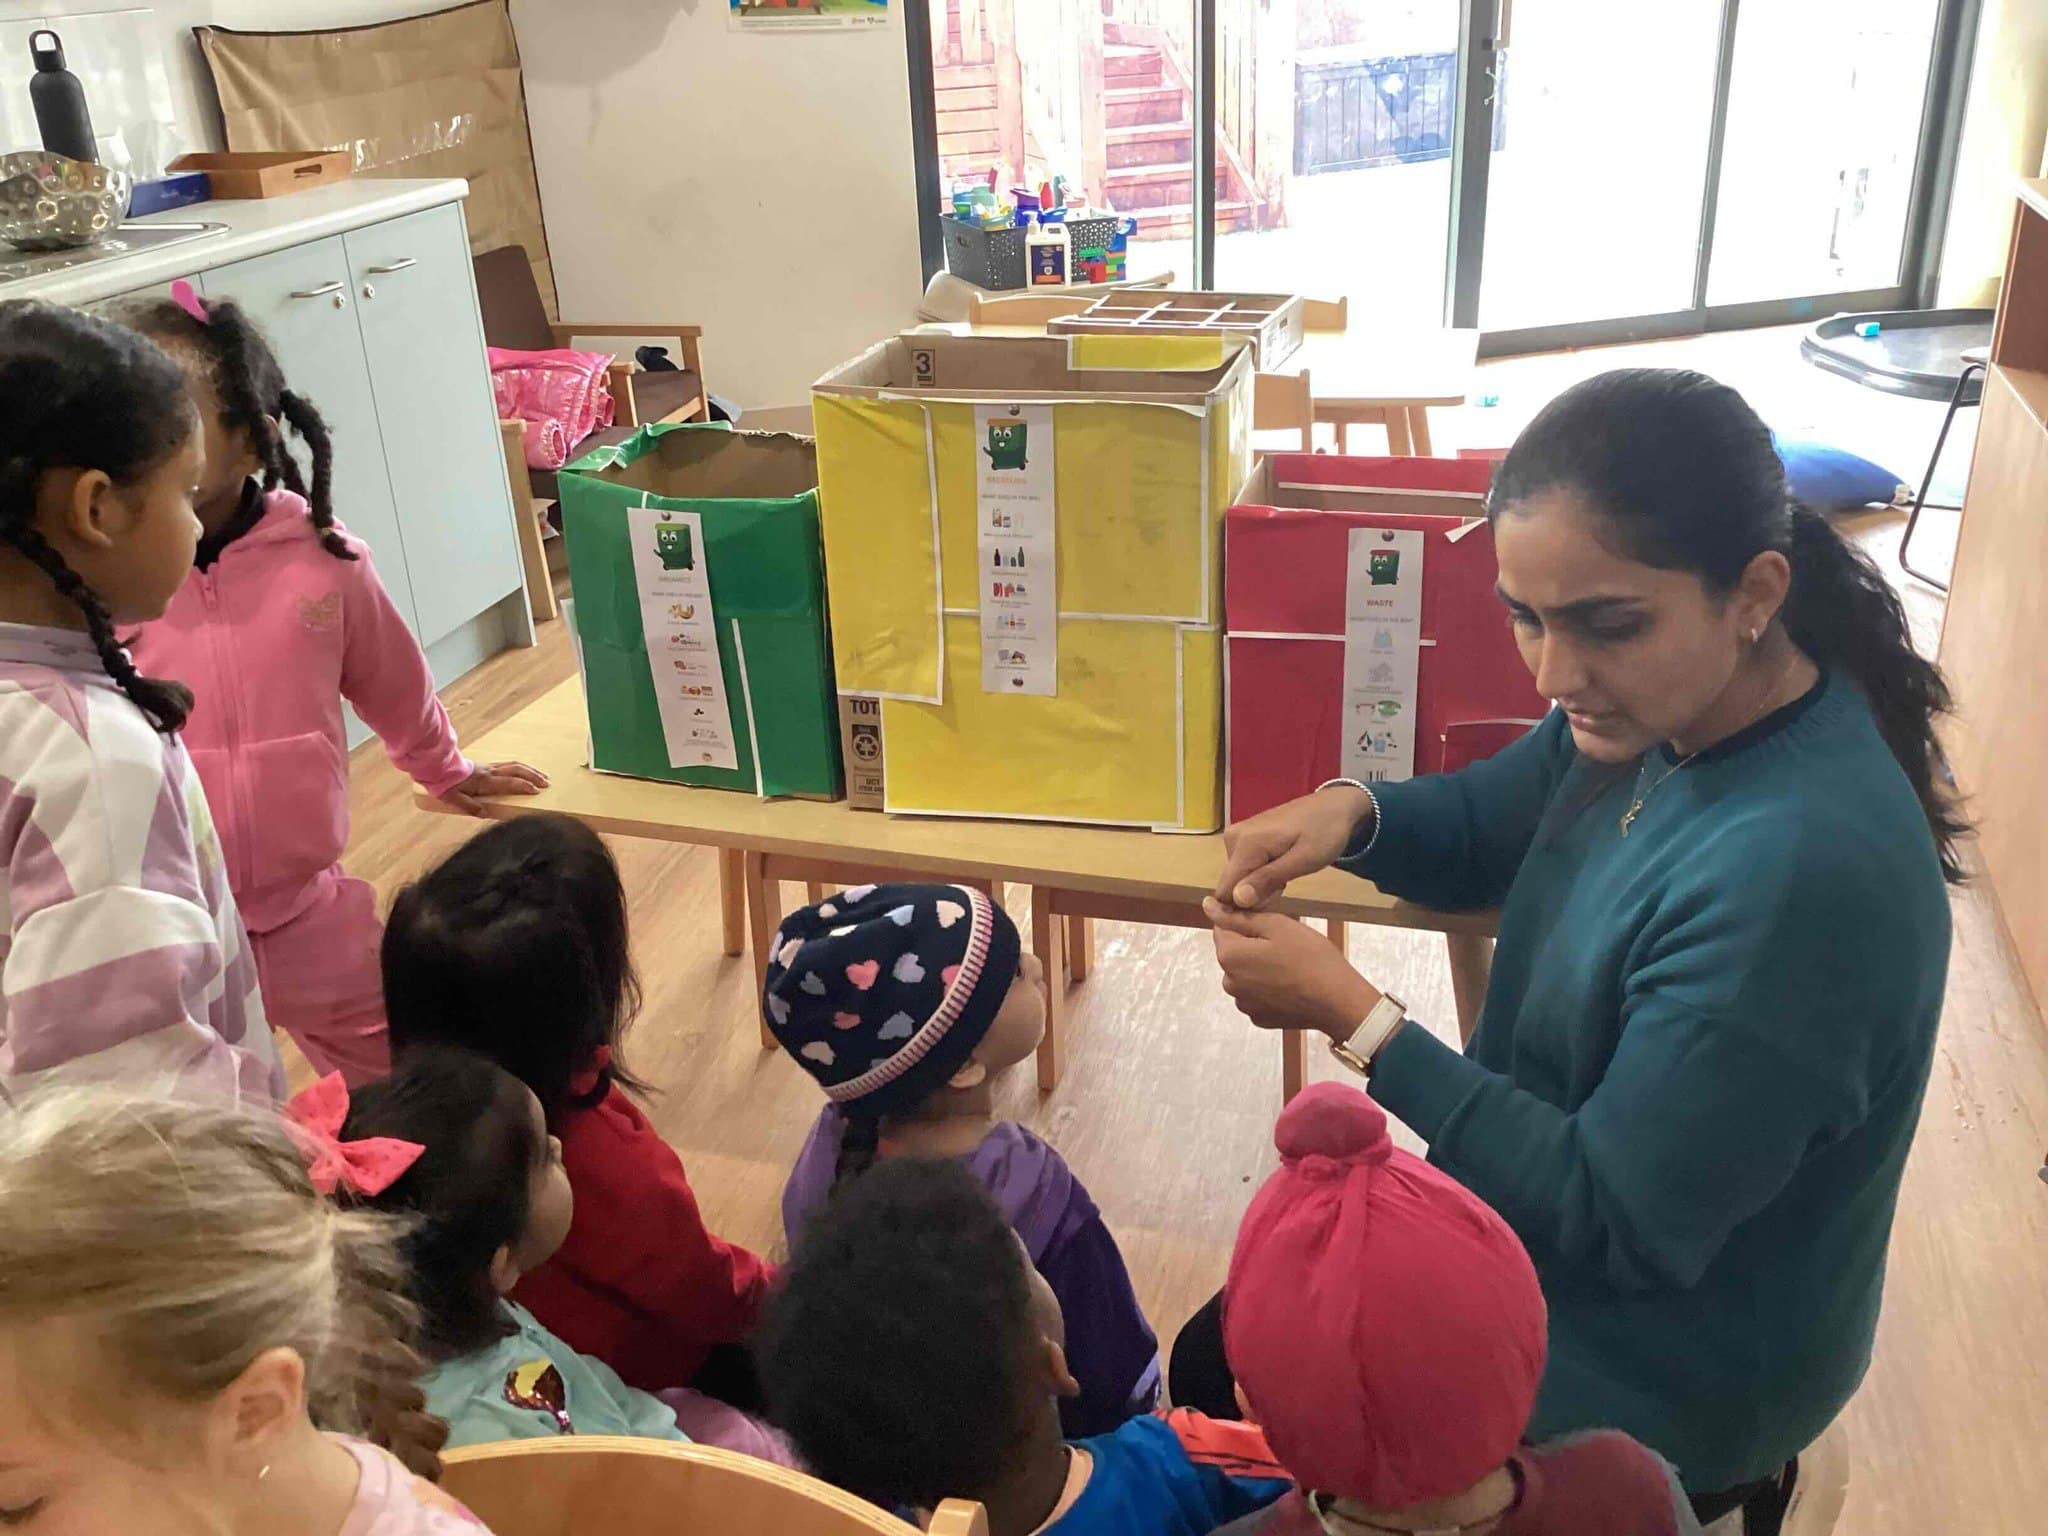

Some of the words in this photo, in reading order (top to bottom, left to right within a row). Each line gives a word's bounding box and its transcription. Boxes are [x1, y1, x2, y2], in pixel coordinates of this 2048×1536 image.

[916, 352, 931, 374] 3
[1366, 599, 1394, 607] WASTE
[849, 699, 880, 715] TOT
